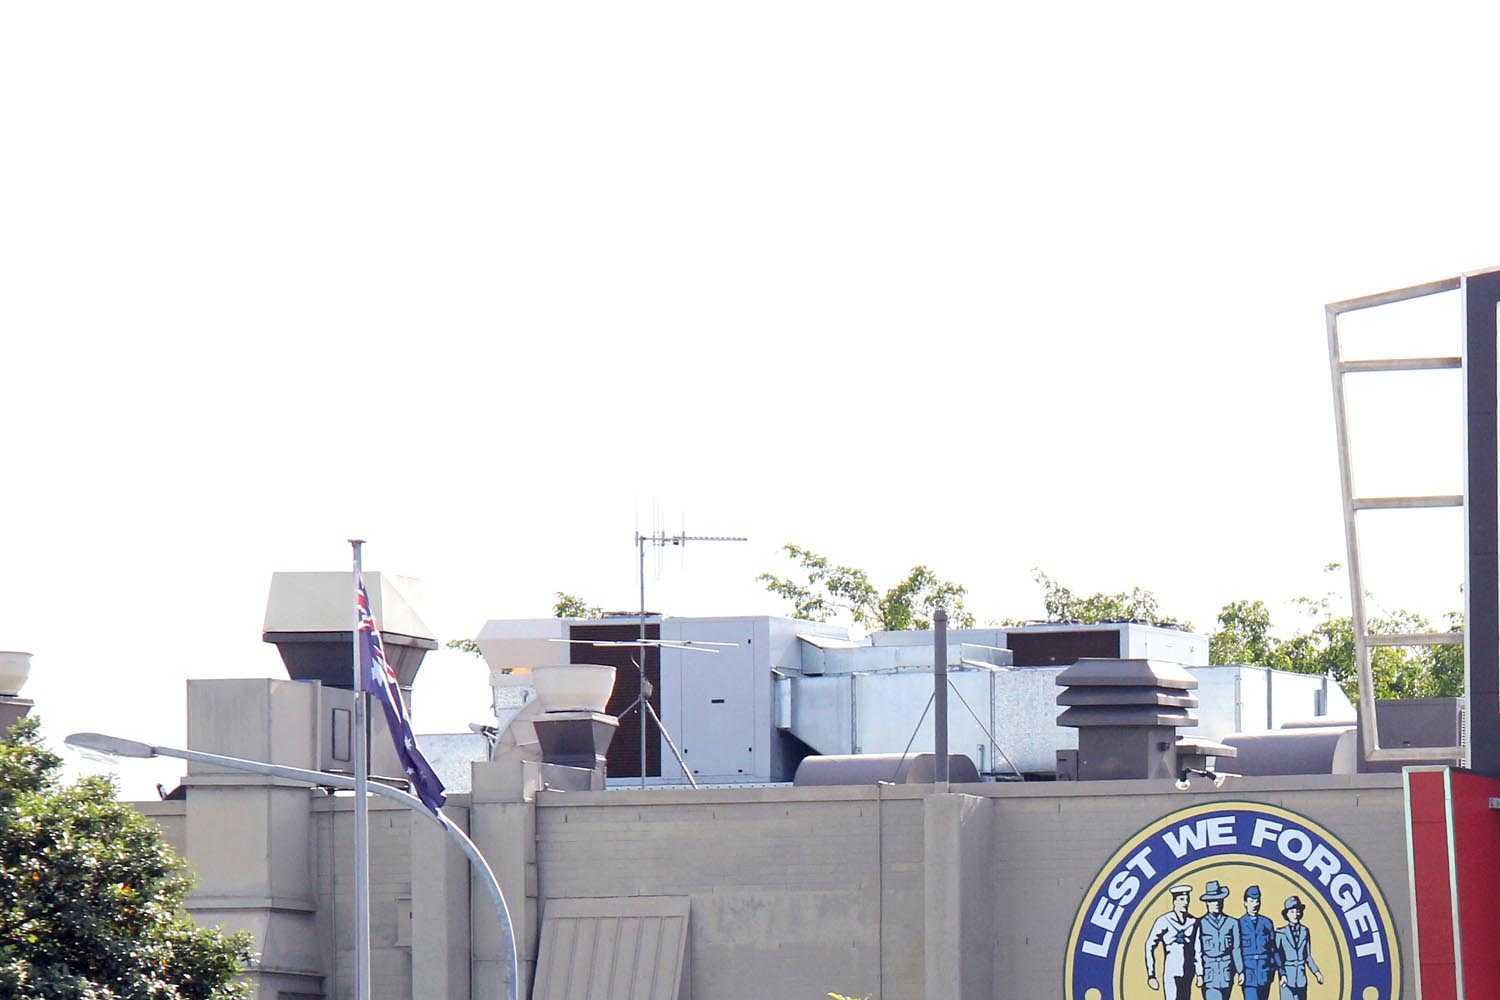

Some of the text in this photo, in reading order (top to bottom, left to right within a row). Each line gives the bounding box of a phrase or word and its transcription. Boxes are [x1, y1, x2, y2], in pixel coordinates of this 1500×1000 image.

[1082, 816, 1385, 966] LEST WE FORGET
